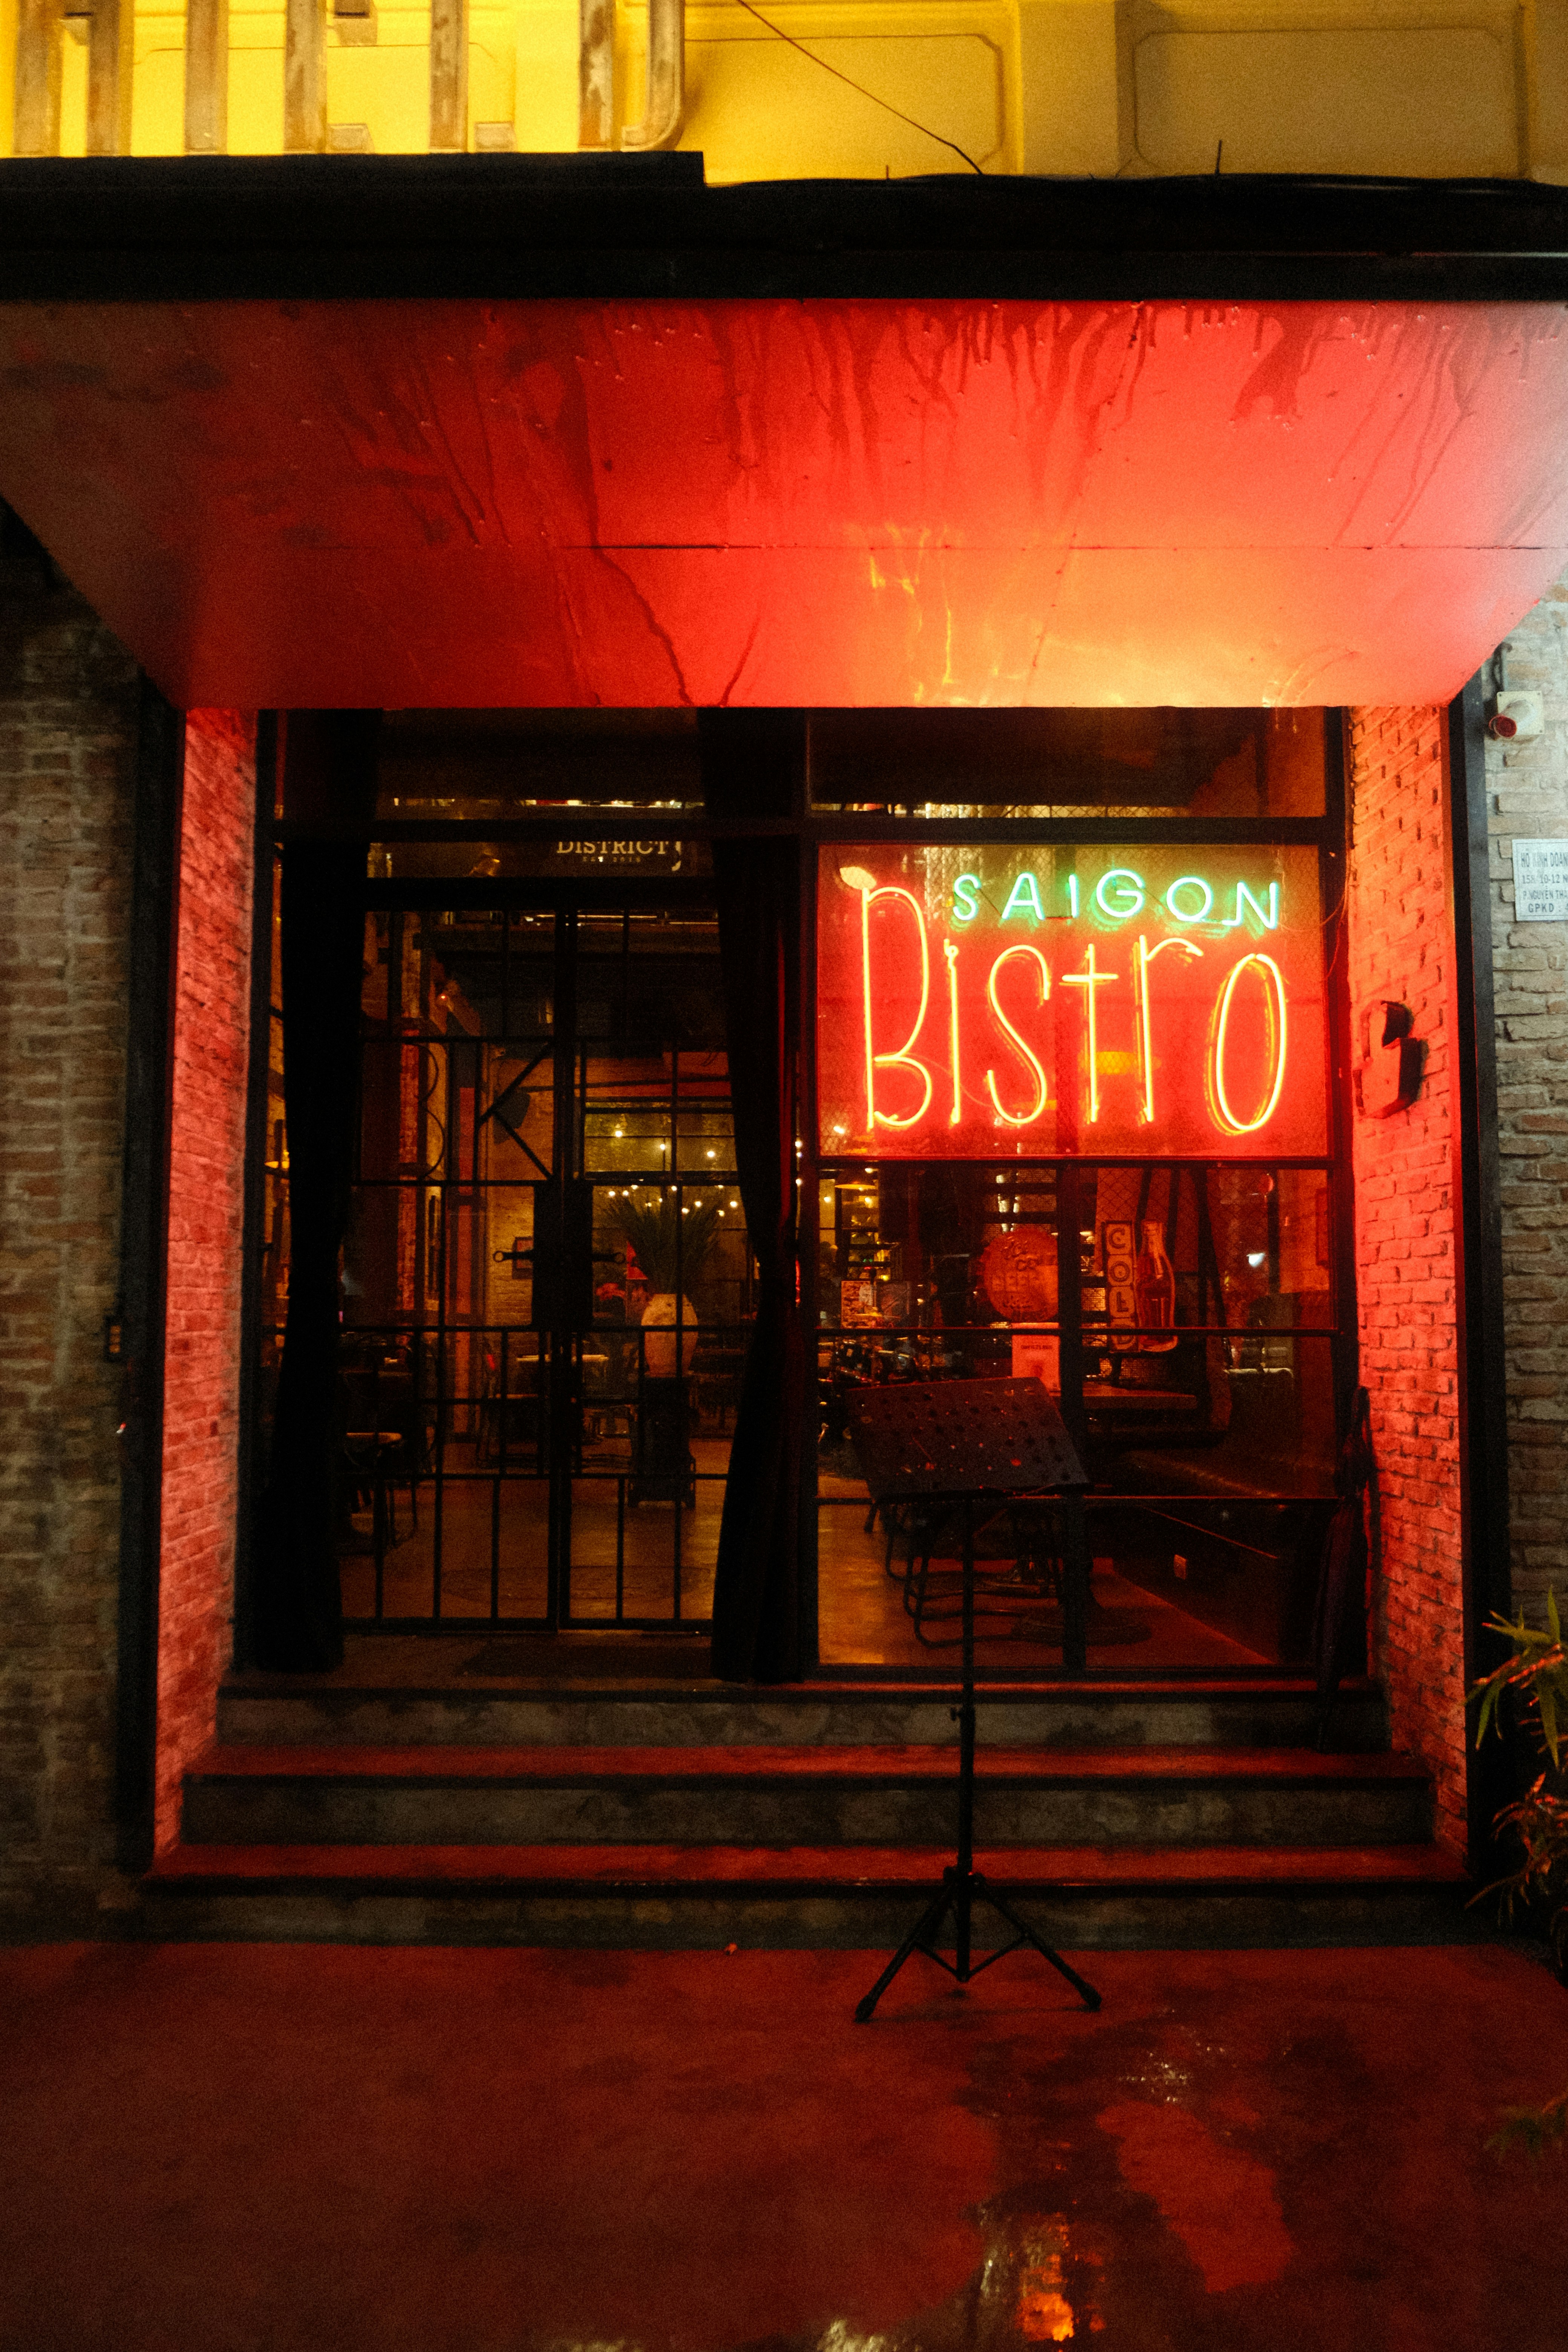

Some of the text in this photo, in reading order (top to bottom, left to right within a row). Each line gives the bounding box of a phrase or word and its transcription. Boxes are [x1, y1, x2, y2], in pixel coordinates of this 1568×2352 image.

[556, 841, 669, 854] DISTRICT
[952, 868, 1279, 929] SAIGON
[1528, 903, 1554, 913] GPKD
